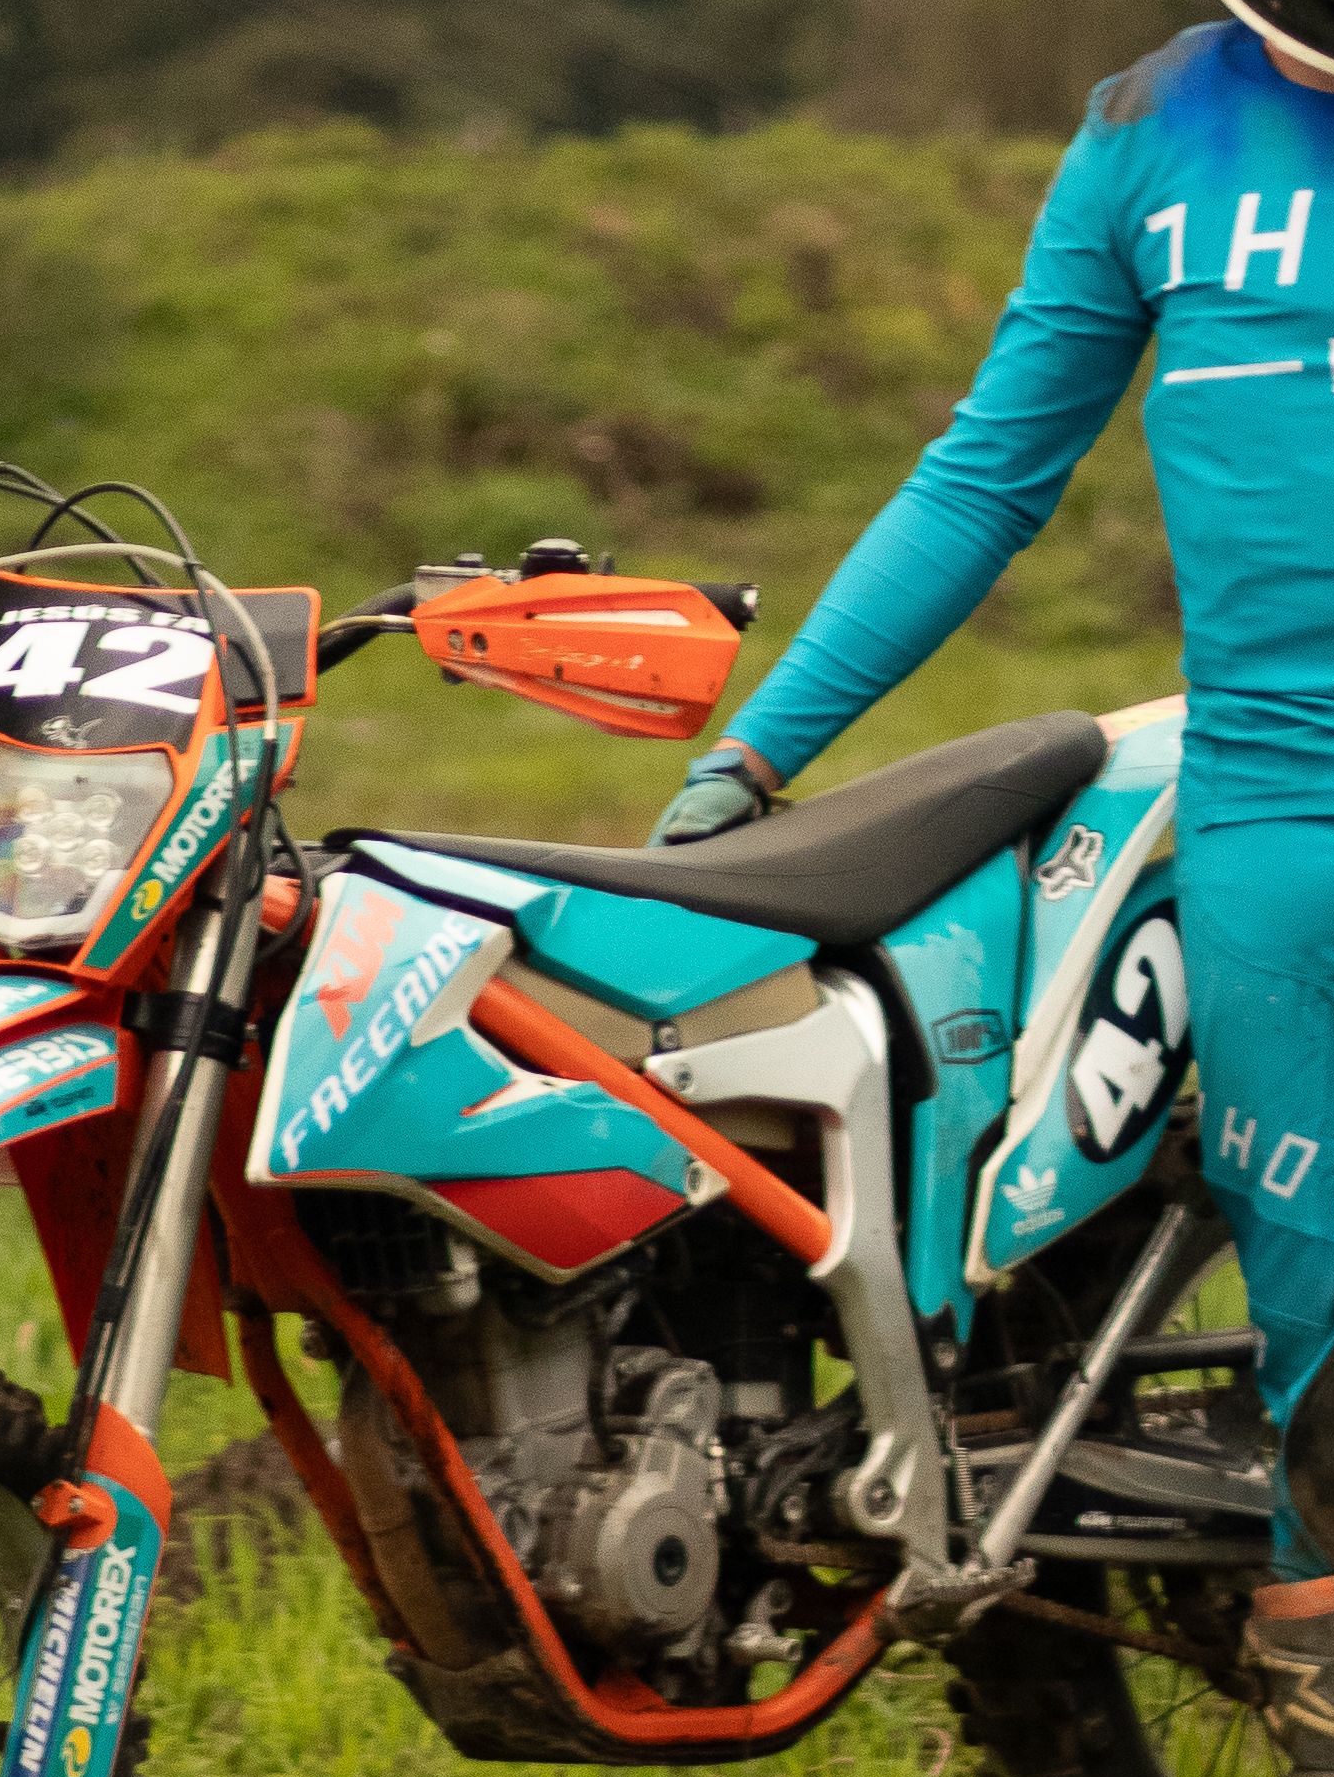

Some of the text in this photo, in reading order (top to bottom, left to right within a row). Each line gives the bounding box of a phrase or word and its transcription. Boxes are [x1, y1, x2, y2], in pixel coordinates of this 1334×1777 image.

[280, 909, 480, 1170] FREERIDE
[1073, 916, 1190, 1154] 42
[69, 1541, 137, 1725] MOTOREX
